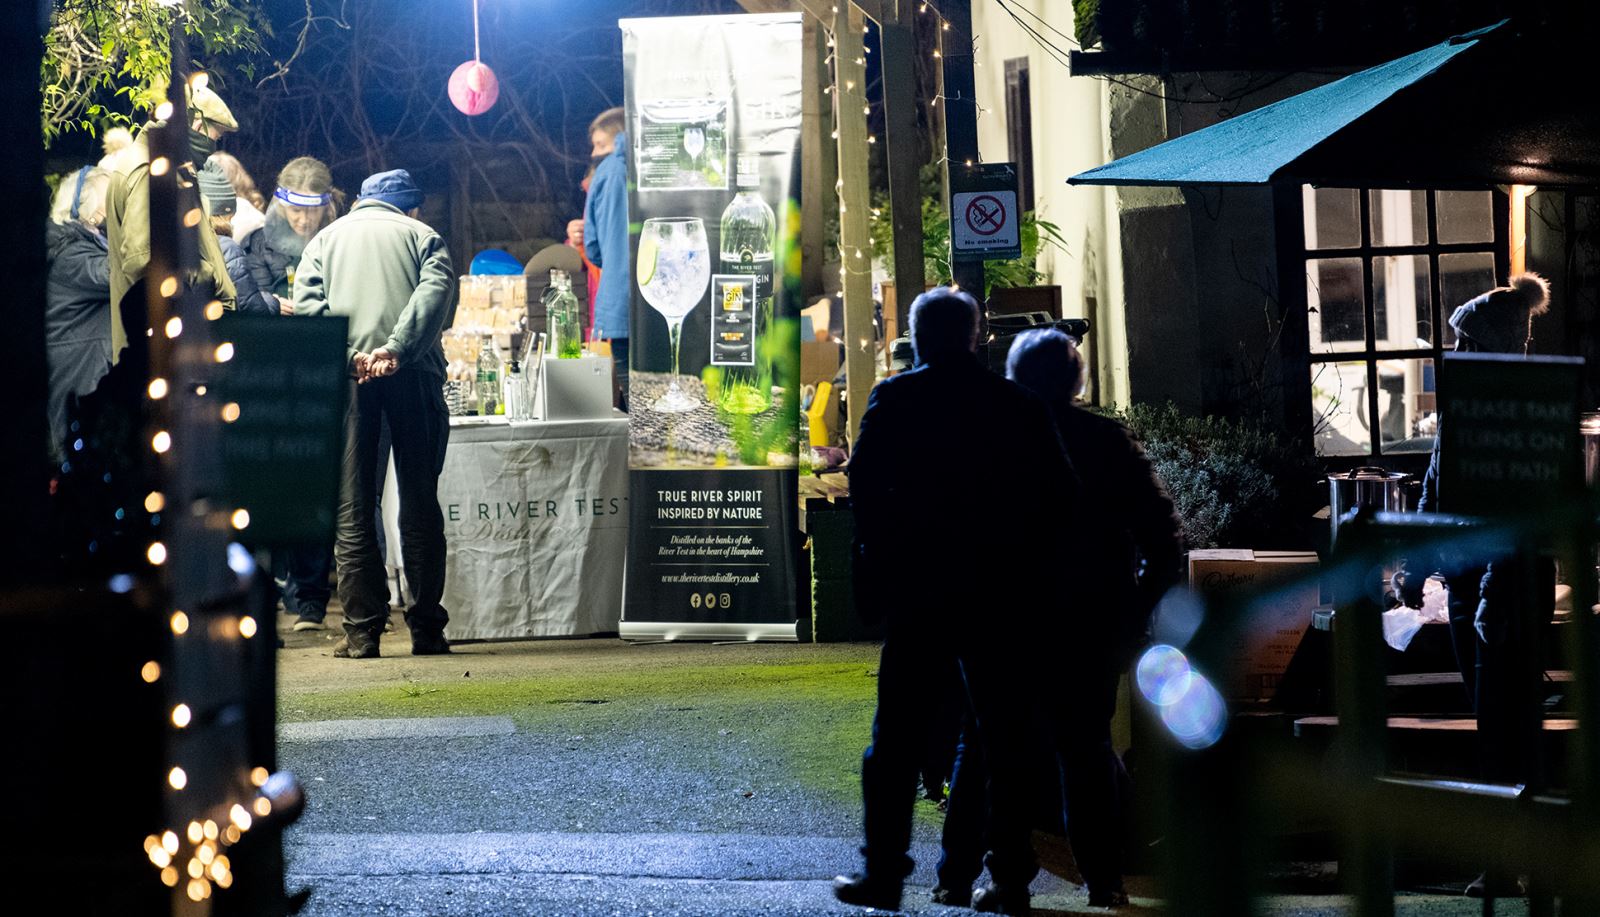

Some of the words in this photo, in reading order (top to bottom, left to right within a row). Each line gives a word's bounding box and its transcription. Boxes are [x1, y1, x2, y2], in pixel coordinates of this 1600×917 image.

[725, 292, 742, 302] GIN
[657, 490, 687, 502] TRUE
[691, 490, 723, 502] RIVER
[727, 490, 763, 502] SPIRIT
[478, 500, 558, 519] RIVER
[575, 497, 628, 516] TES
[657, 507, 704, 519] INSPIRED
[707, 507, 720, 519] BY
[722, 507, 762, 519] NATURE
[670, 535, 696, 544] Distilled
[705, 535, 715, 544] the
[715, 535, 734, 544] banks
[734, 535, 743, 546] of
[742, 535, 752, 544] the
[658, 546, 675, 556] River
[676, 546, 688, 555] Test
[689, 546, 696, 555] in
[696, 546, 706, 555] the
[706, 546, 722, 556] heart
[723, 546, 731, 557] of
[730, 546, 764, 557] Hampshire
[661, 572, 760, 585] www.therivertestdistillery.co.uk
